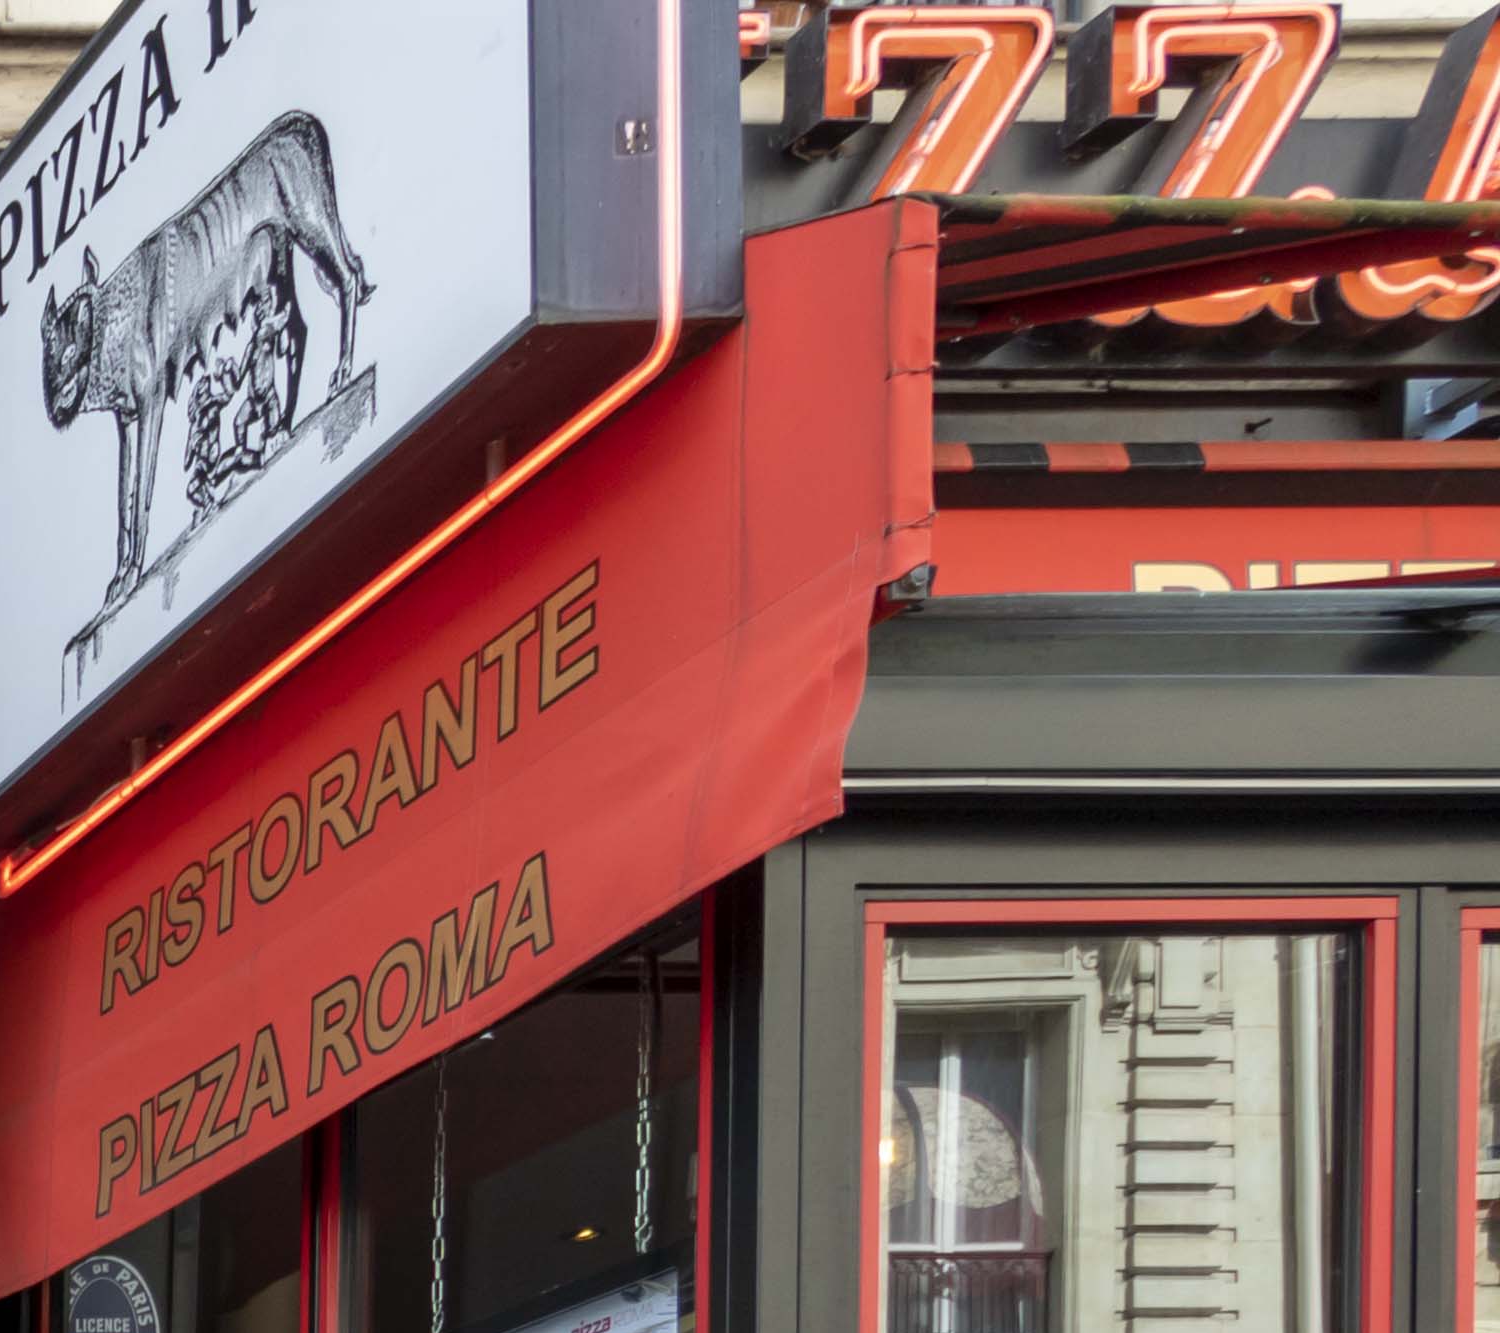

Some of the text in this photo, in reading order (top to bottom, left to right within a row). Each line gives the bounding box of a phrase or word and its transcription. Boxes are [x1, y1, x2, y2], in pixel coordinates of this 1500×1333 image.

[100, 558, 600, 1015] RISTORANTE
[95, 852, 554, 1219] PIZZA ROMA
[75, 1318, 130, 1333] LICENCE
[115, 1268, 153, 1326] PARIS
